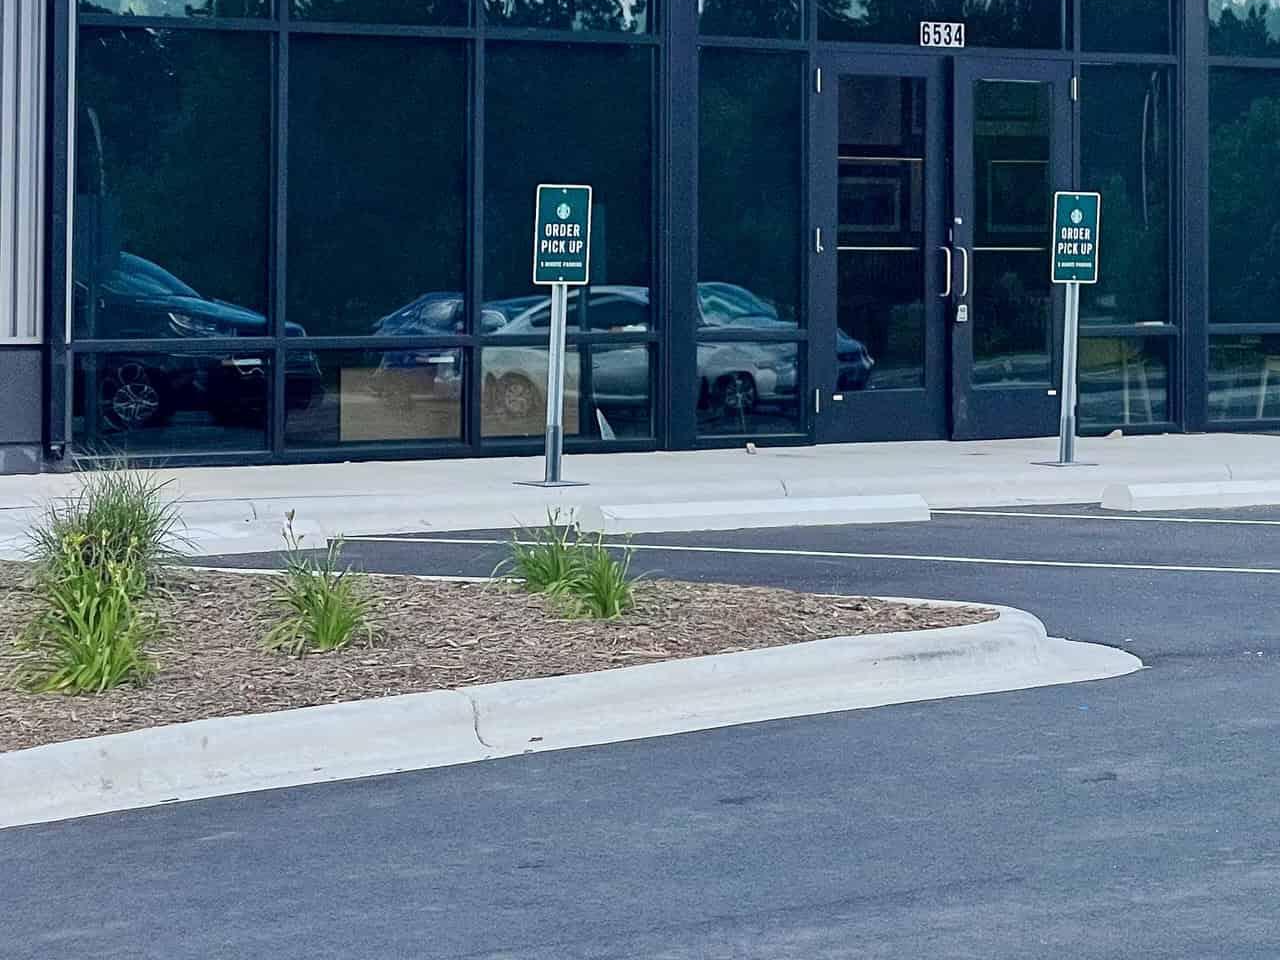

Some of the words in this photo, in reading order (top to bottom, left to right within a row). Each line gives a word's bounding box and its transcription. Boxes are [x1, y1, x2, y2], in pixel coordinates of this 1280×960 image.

[922, 23, 963, 46] 6534
[545, 223, 580, 237] ORDER
[1061, 227, 1091, 241] ORDER
[541, 239, 566, 254] PICK
[568, 240, 583, 254] UP
[1058, 242, 1079, 255] PICK
[1080, 242, 1093, 255] UP
